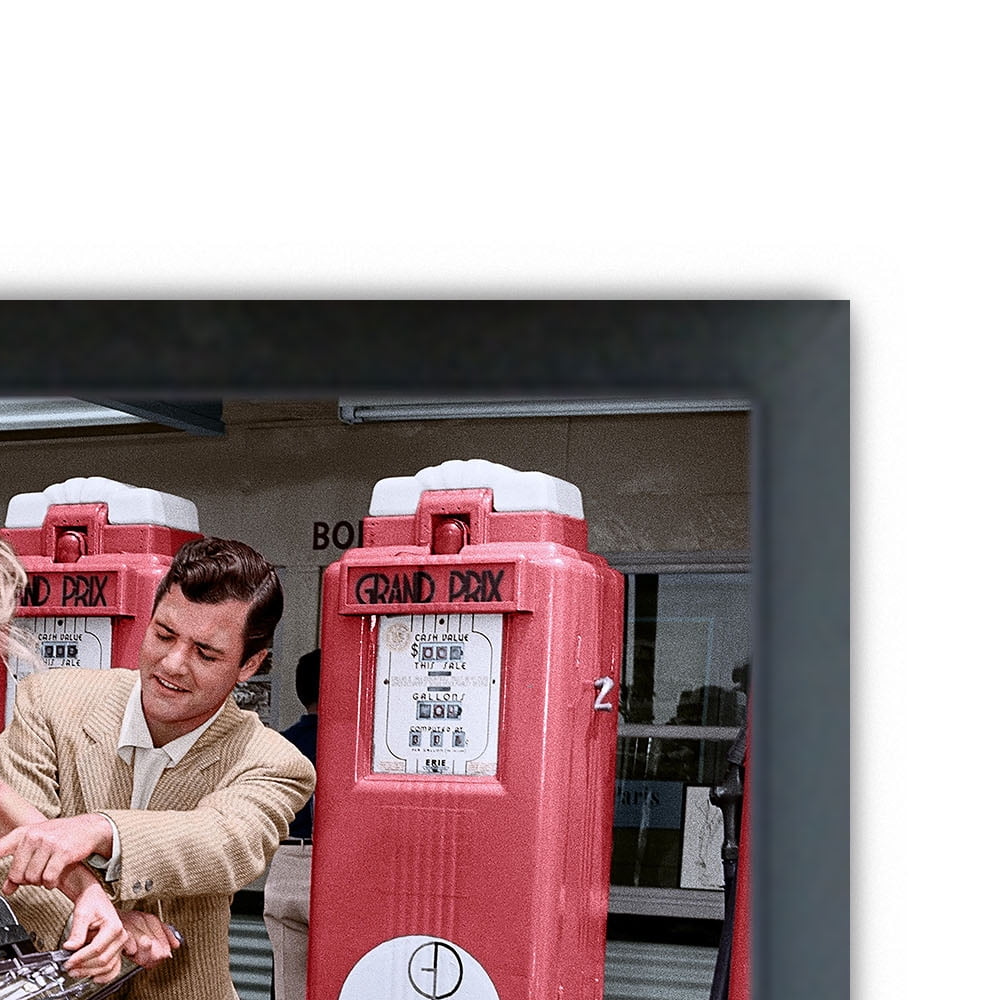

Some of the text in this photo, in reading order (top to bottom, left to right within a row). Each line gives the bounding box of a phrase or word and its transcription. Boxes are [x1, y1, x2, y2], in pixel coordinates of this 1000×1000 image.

[62, 575, 108, 607] PRIX
[355, 569, 504, 604] GRAND PRIX
[414, 633, 470, 642] CASH VALUE
[414, 661, 467, 670] THIS SALE
[412, 692, 466, 702] GALLONS
[425, 759, 446, 767] ERIE
